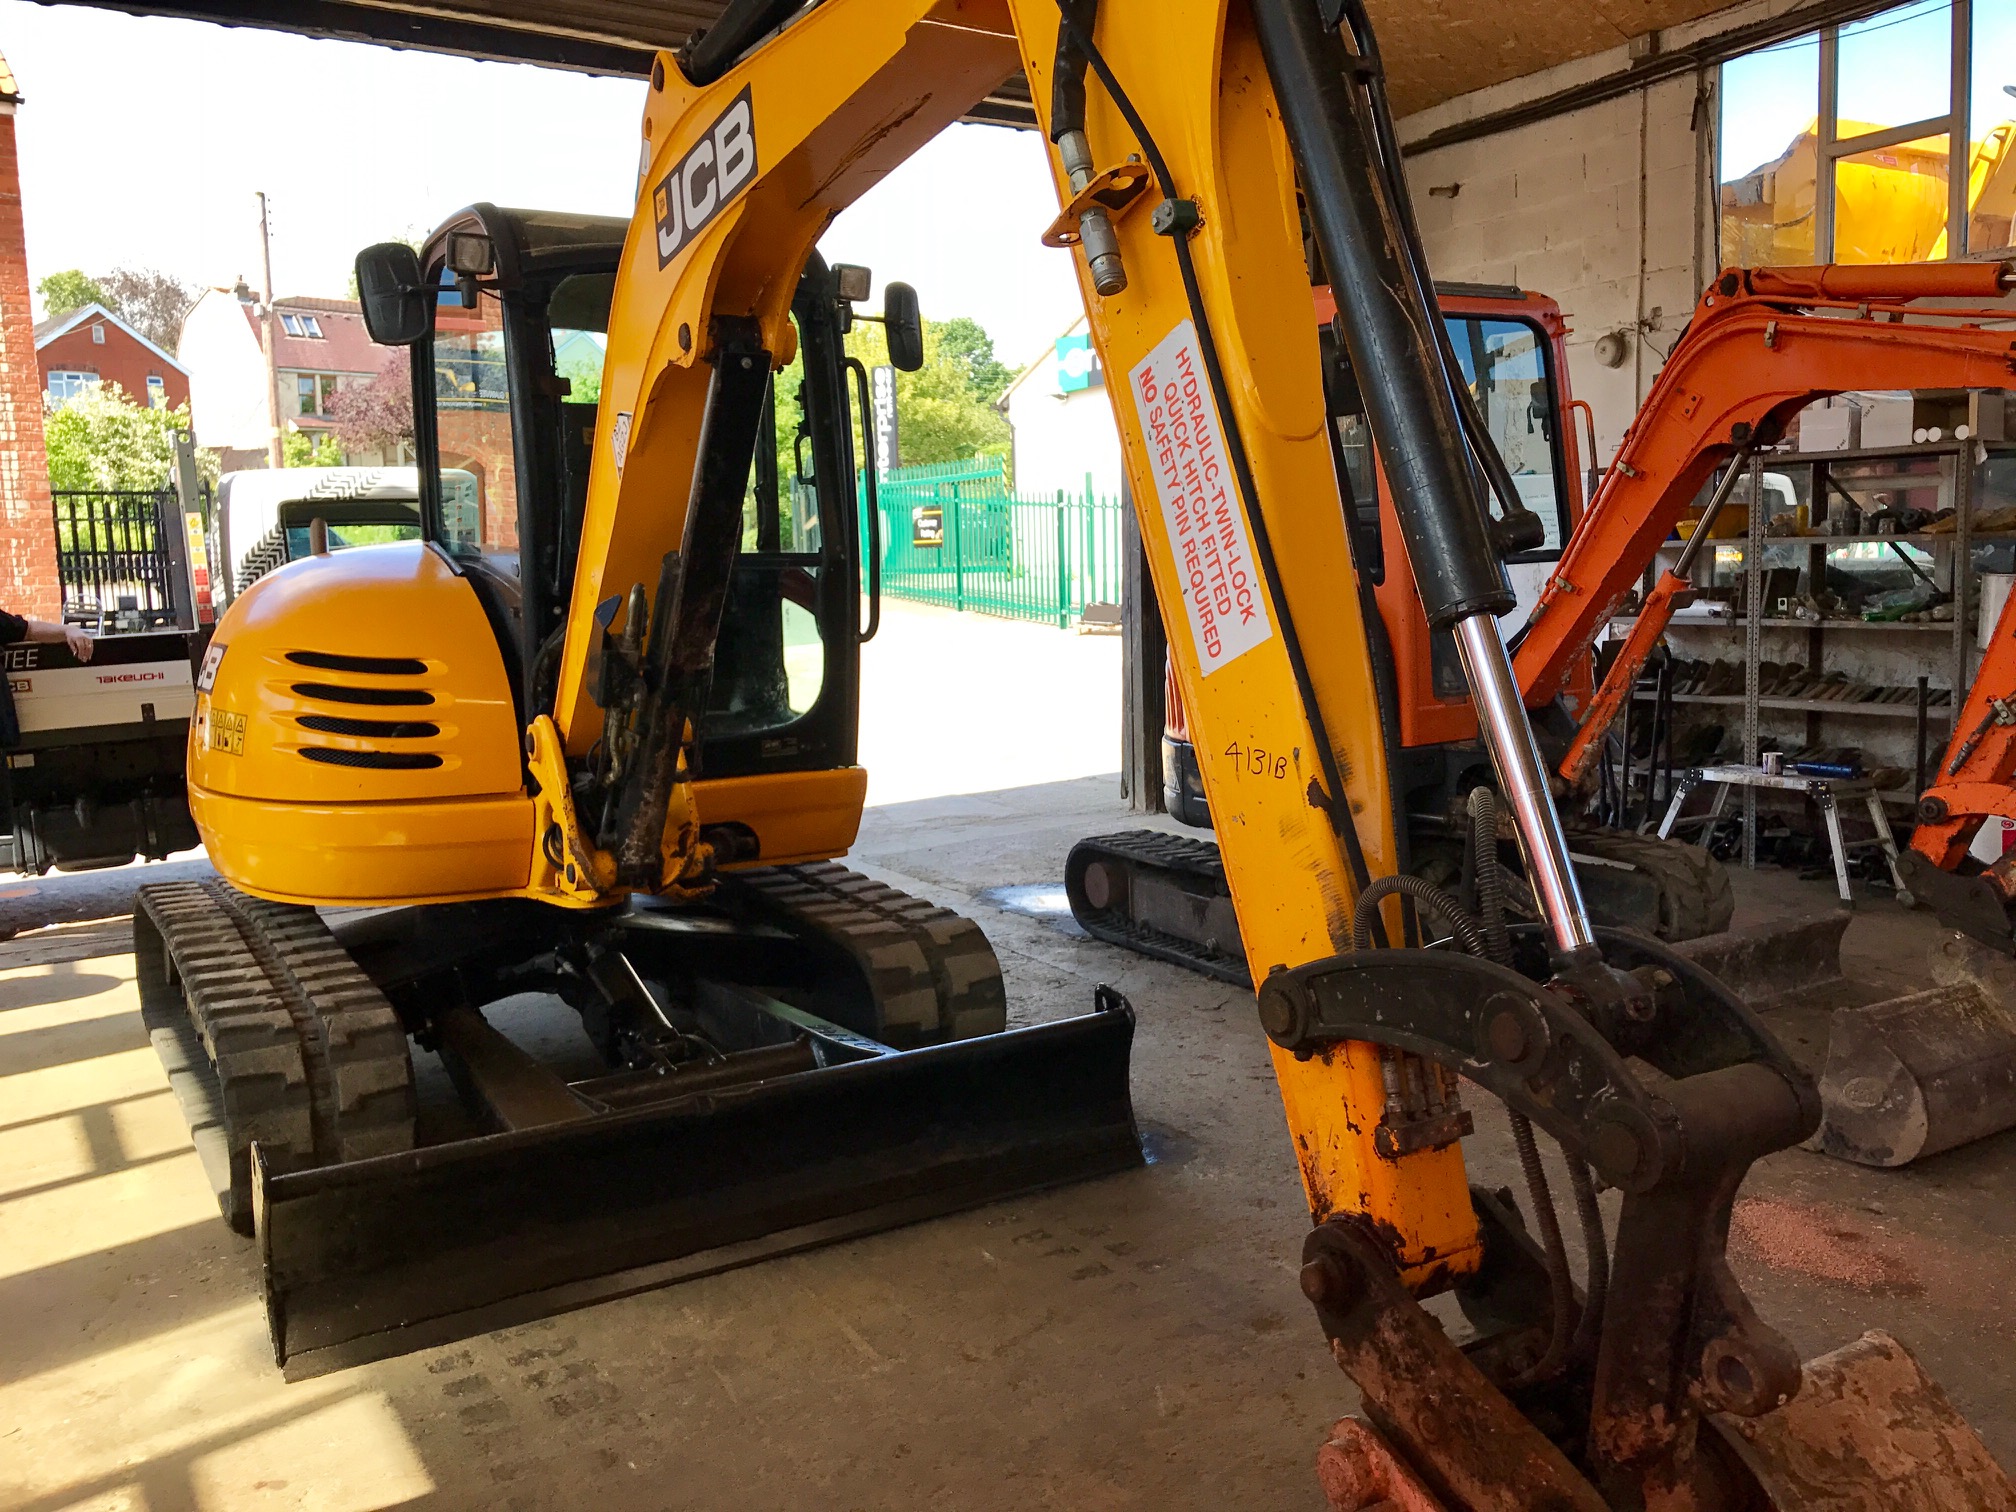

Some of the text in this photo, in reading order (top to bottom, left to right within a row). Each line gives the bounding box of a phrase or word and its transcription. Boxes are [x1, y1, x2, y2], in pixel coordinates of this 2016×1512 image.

[658, 100, 754, 258] JCB
[1139, 365, 1222, 659] NO SAFETY PIN REQUIRED
[1164, 382, 1232, 616] QUICK HITCH FITTED
[4, 649, 39, 669] TEE
[1224, 741, 1288, 780] 4131B
